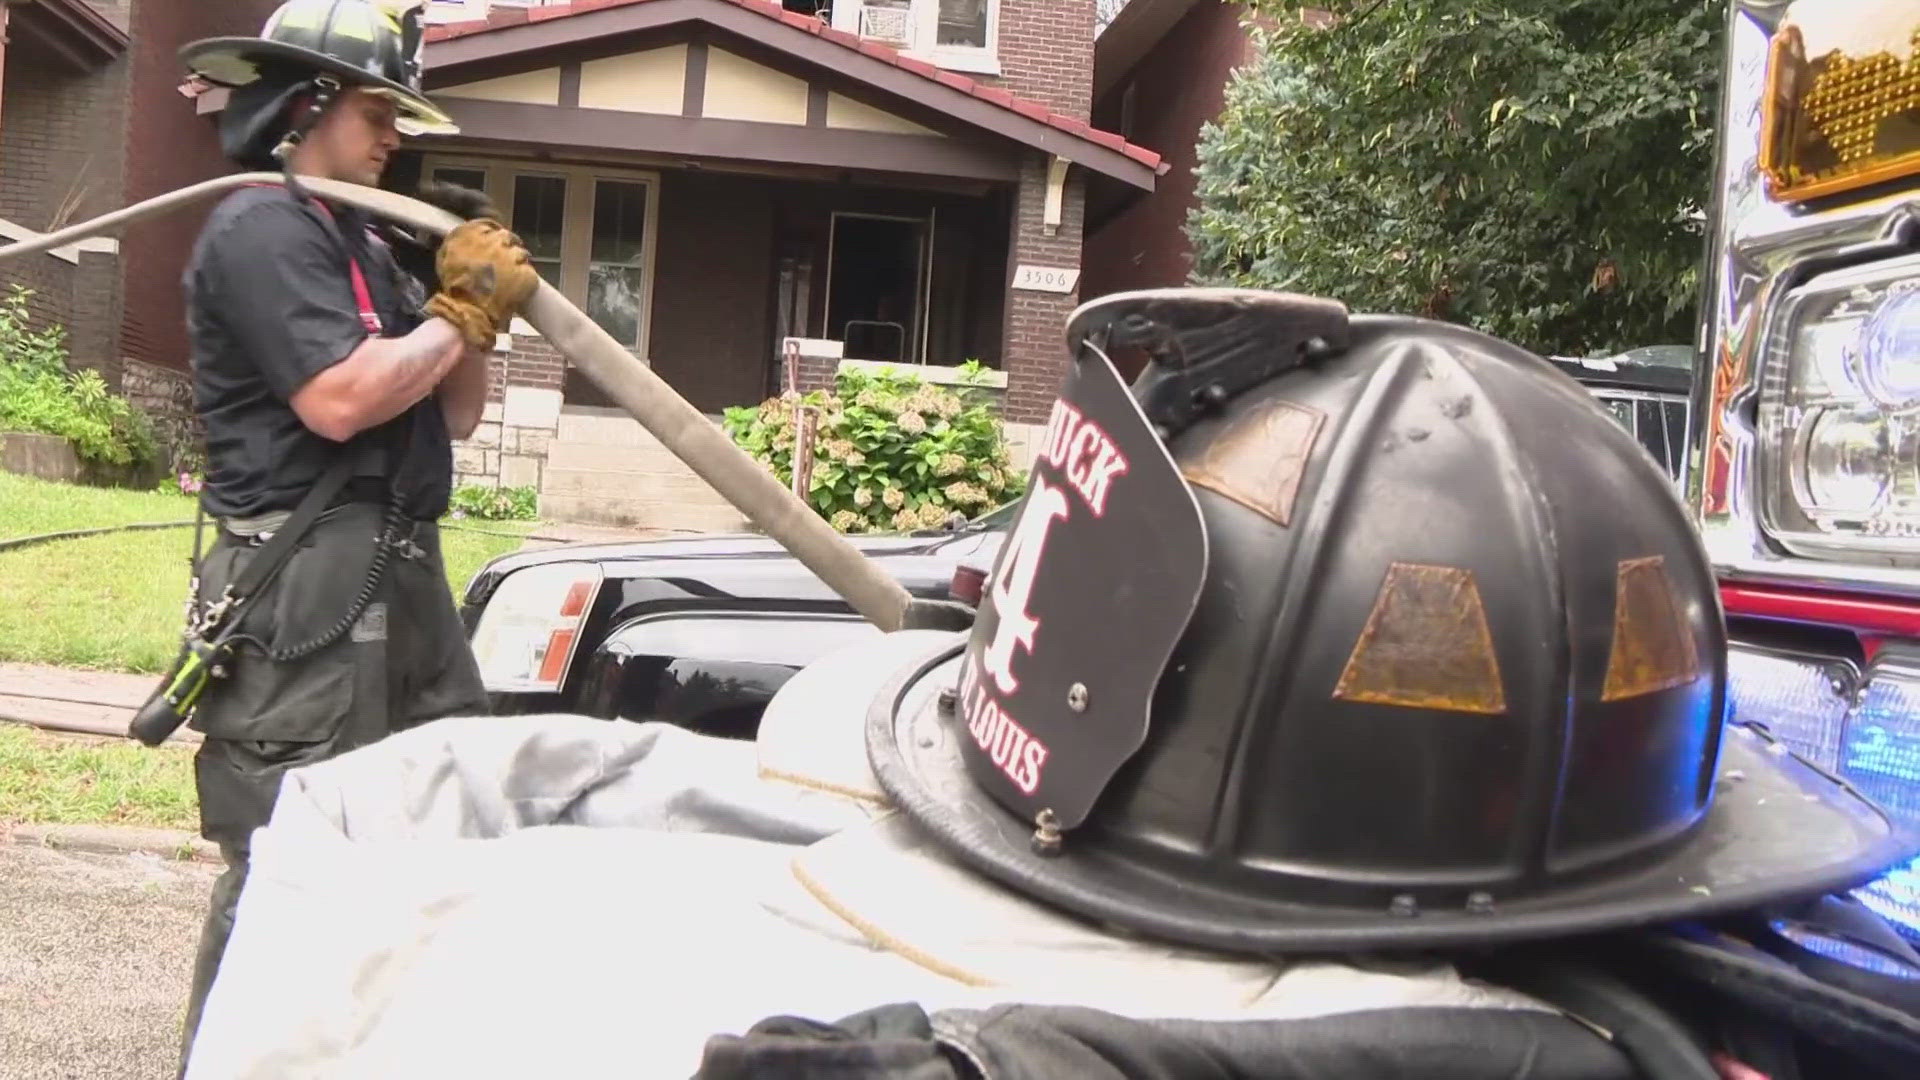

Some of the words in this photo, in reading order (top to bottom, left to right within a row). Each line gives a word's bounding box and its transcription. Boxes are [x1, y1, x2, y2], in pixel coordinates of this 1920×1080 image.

[1025, 270, 1066, 287] 3506
[984, 472, 1068, 695] 4
[968, 684, 1049, 793] LOUIS
